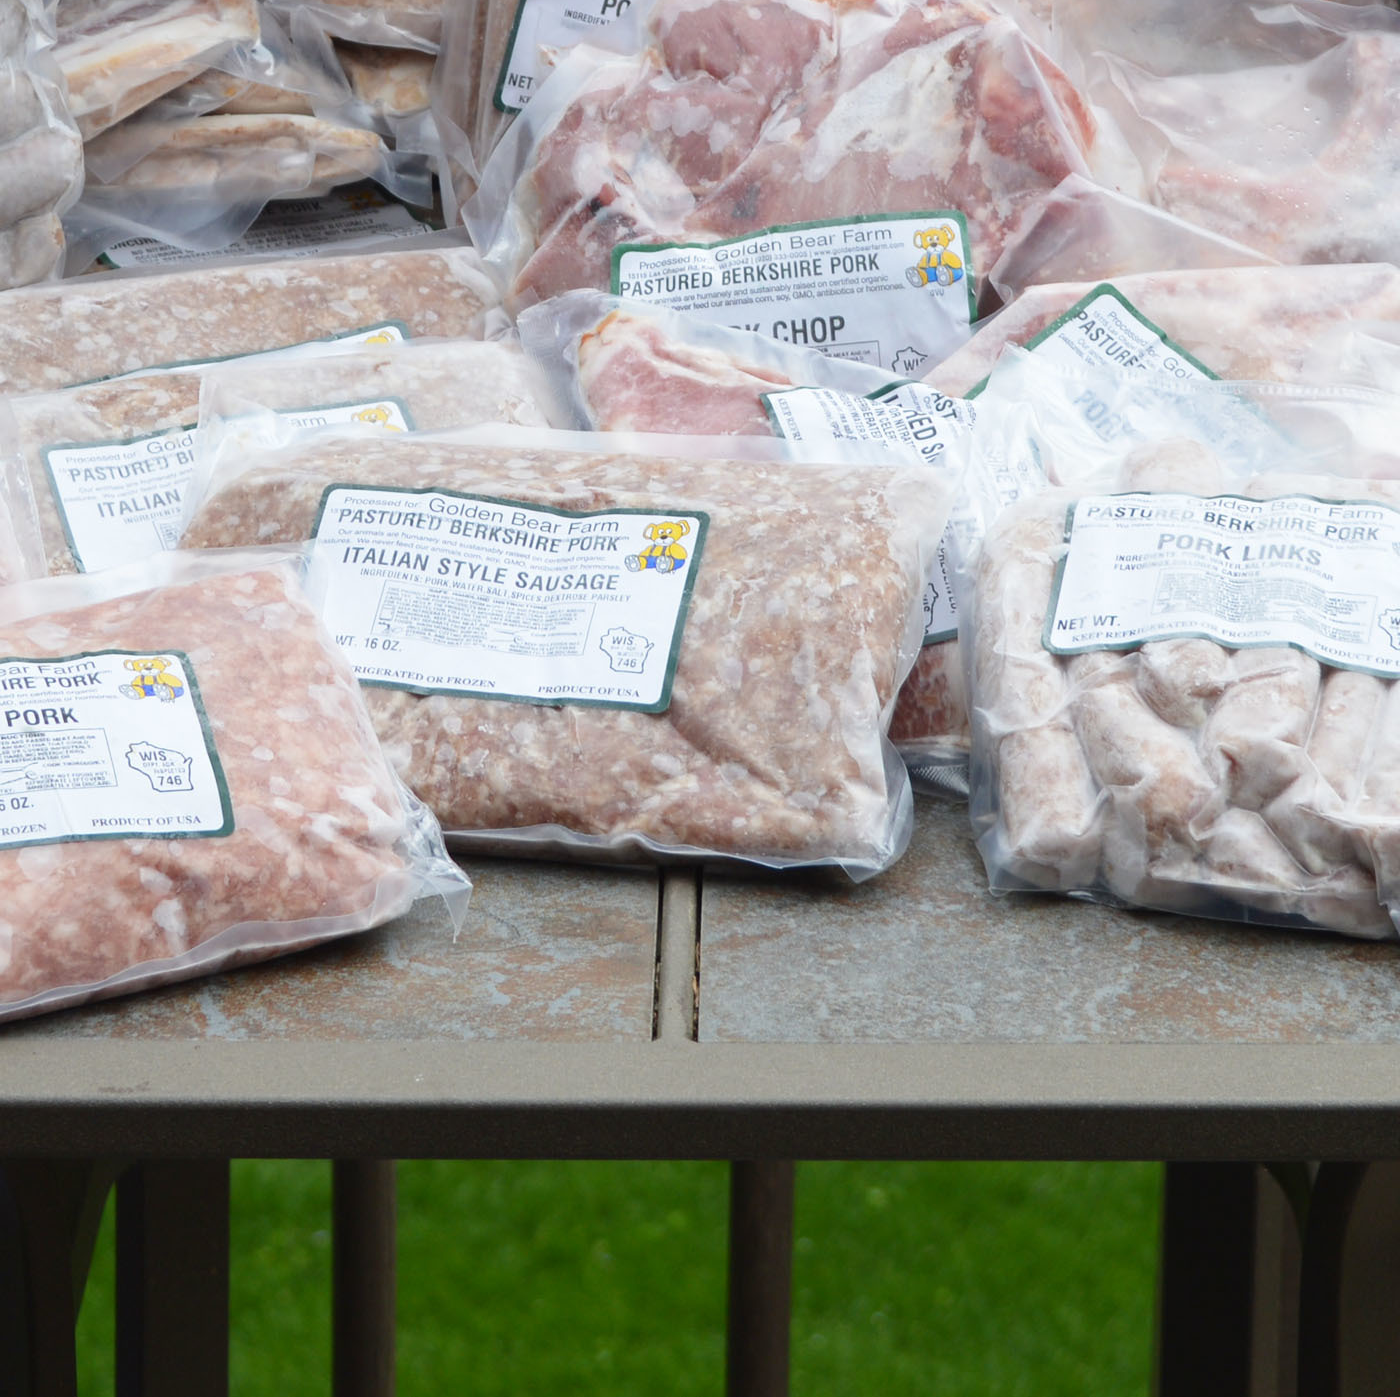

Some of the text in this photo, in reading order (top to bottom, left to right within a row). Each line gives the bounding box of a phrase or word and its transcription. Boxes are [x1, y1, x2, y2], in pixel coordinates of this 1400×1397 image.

[507, 72, 534, 90] NET
[639, 228, 892, 271] Processed Golden Bear Farm
[619, 252, 880, 297] PASTURED BERKSHIRE PORK
[696, 289, 733, 303] humanely
[733, 287, 749, 296] and
[749, 283, 792, 296] sustainably
[772, 314, 846, 345] CHOP
[146, 433, 194, 455] Gold
[68, 457, 169, 483] PASTURED
[96, 488, 182, 518] ITALIAN
[1271, 500, 1321, 515] Bear
[1328, 506, 1384, 521] Farm
[343, 496, 620, 536] Processed Golden Bear Farm
[1086, 505, 1381, 542] PASTURED BERKSHIRE PORK
[337, 508, 620, 554] PASTURED BERKSHIRE PORK
[1156, 532, 1323, 567] PORK LINKS
[342, 546, 620, 591] ITALIAN STYLE SAUSAGE
[360, 567, 423, 583] INGREDIENTS:
[1056, 614, 1121, 631] NET WT.
[363, 637, 403, 652] 16 OZ.
[37, 660, 97, 675] Farm
[617, 657, 638, 669] 746
[44, 671, 103, 689] PORK
[351, 664, 641, 699] RIGERATED OR FROZEN PRODUCT OF USA
[4, 706, 80, 728] PORK
[157, 775, 183, 786] 746
[10, 796, 35, 811] OZ.
[91, 816, 153, 828] PRODUCT
[156, 816, 174, 827] OF
[176, 814, 203, 825] USA
